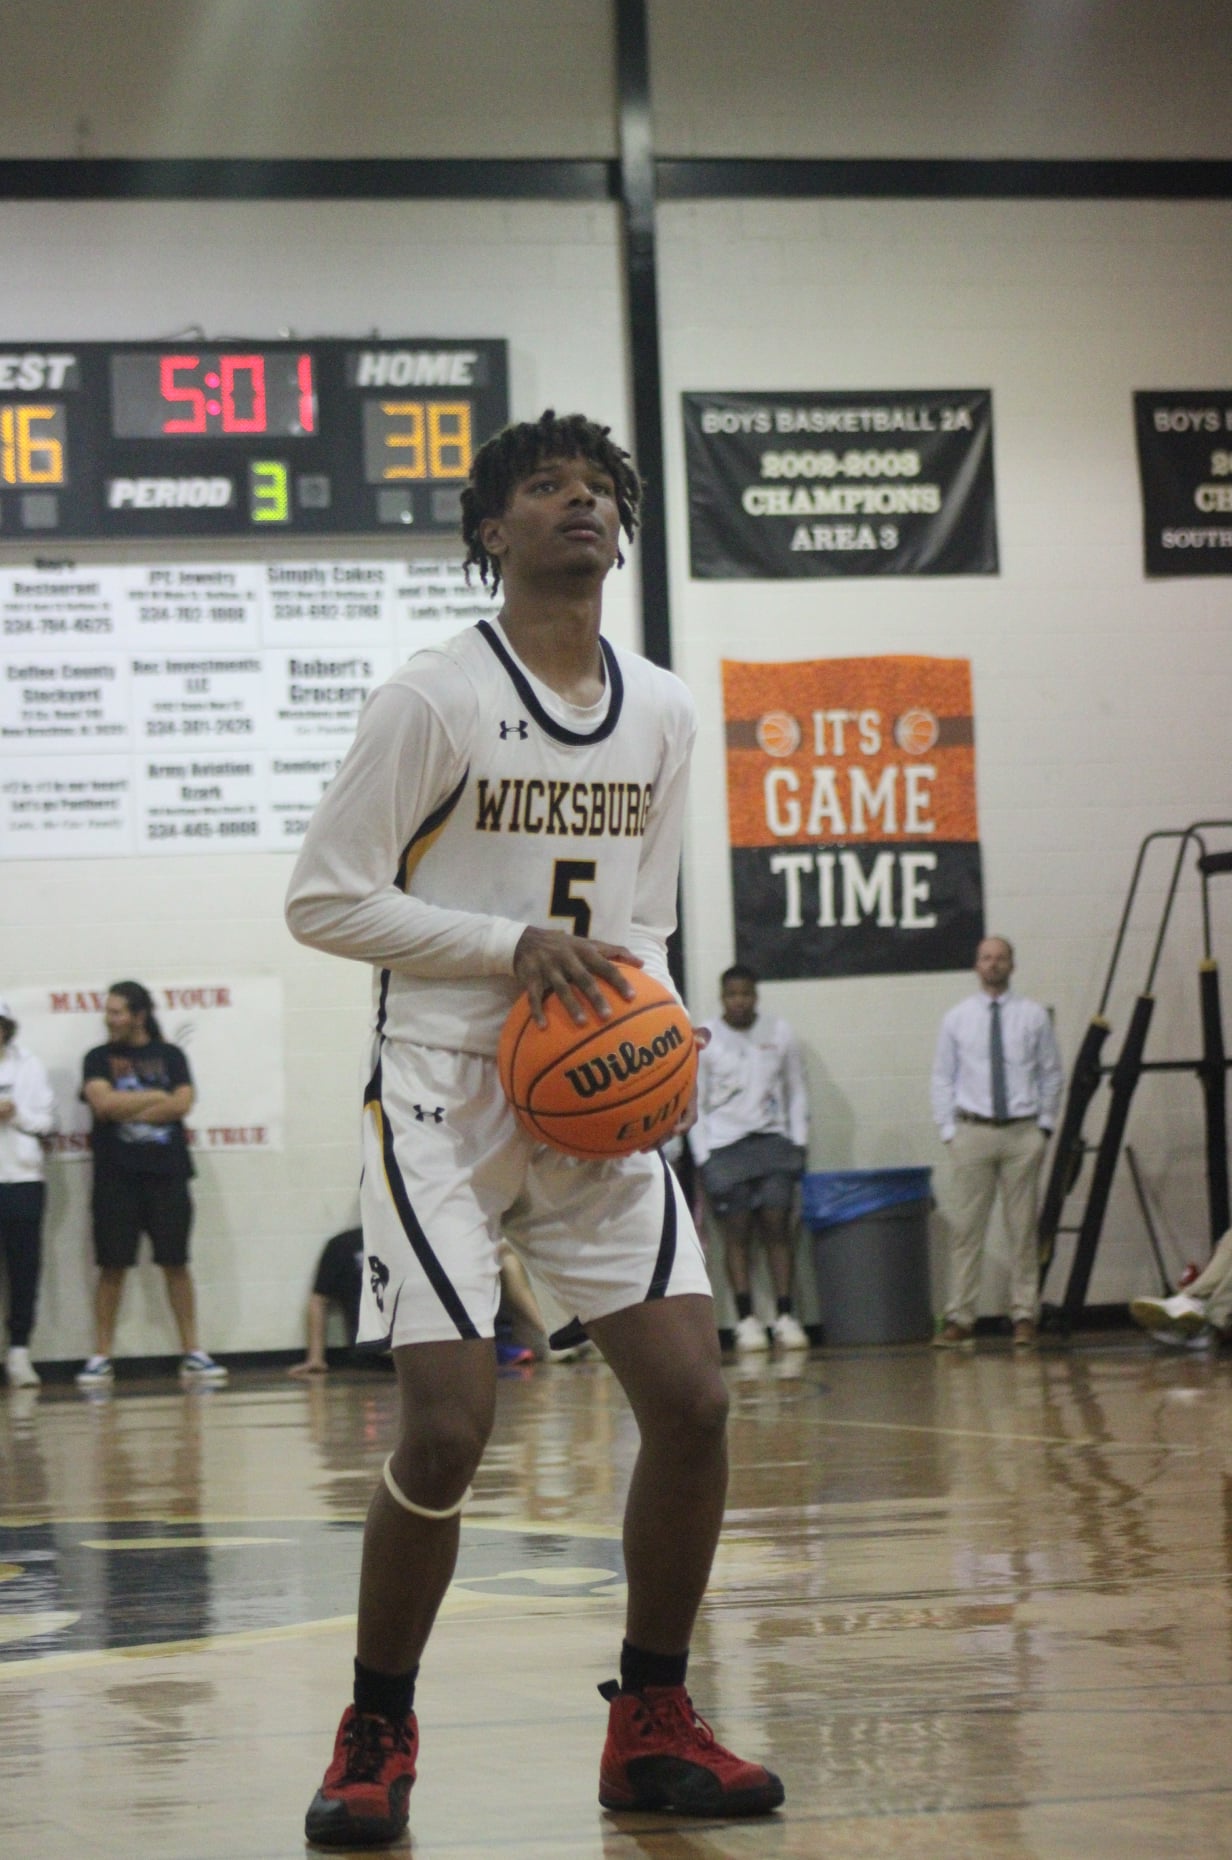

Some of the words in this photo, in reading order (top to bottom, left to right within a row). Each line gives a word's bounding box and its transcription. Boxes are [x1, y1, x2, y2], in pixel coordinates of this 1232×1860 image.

[0, 354, 75, 390] EST
[357, 352, 477, 386] HOME
[159, 355, 314, 433] 5:01
[702, 409, 771, 432] BOYS
[776, 406, 933, 430] BASKETBALL
[1153, 408, 1221, 432] BOYS
[0, 404, 64, 484] 16
[382, 402, 472, 479] 38
[108, 477, 232, 508] PERIOD
[251, 462, 288, 520] 3
[742, 484, 941, 516] CHAMPIONS
[791, 524, 876, 551] AREA
[880, 524, 899, 549] 3
[13, 581, 98, 596] Restaurant
[289, 659, 372, 677] Robert's
[813, 709, 881, 756] IT'S
[764, 764, 936, 837] GAME
[549, 857, 597, 938] 5
[770, 852, 937, 929] TIME
[163, 988, 232, 1009] YOUR
[564, 1025, 684, 1098] Wilson
[208, 1127, 267, 1145] TRUE
